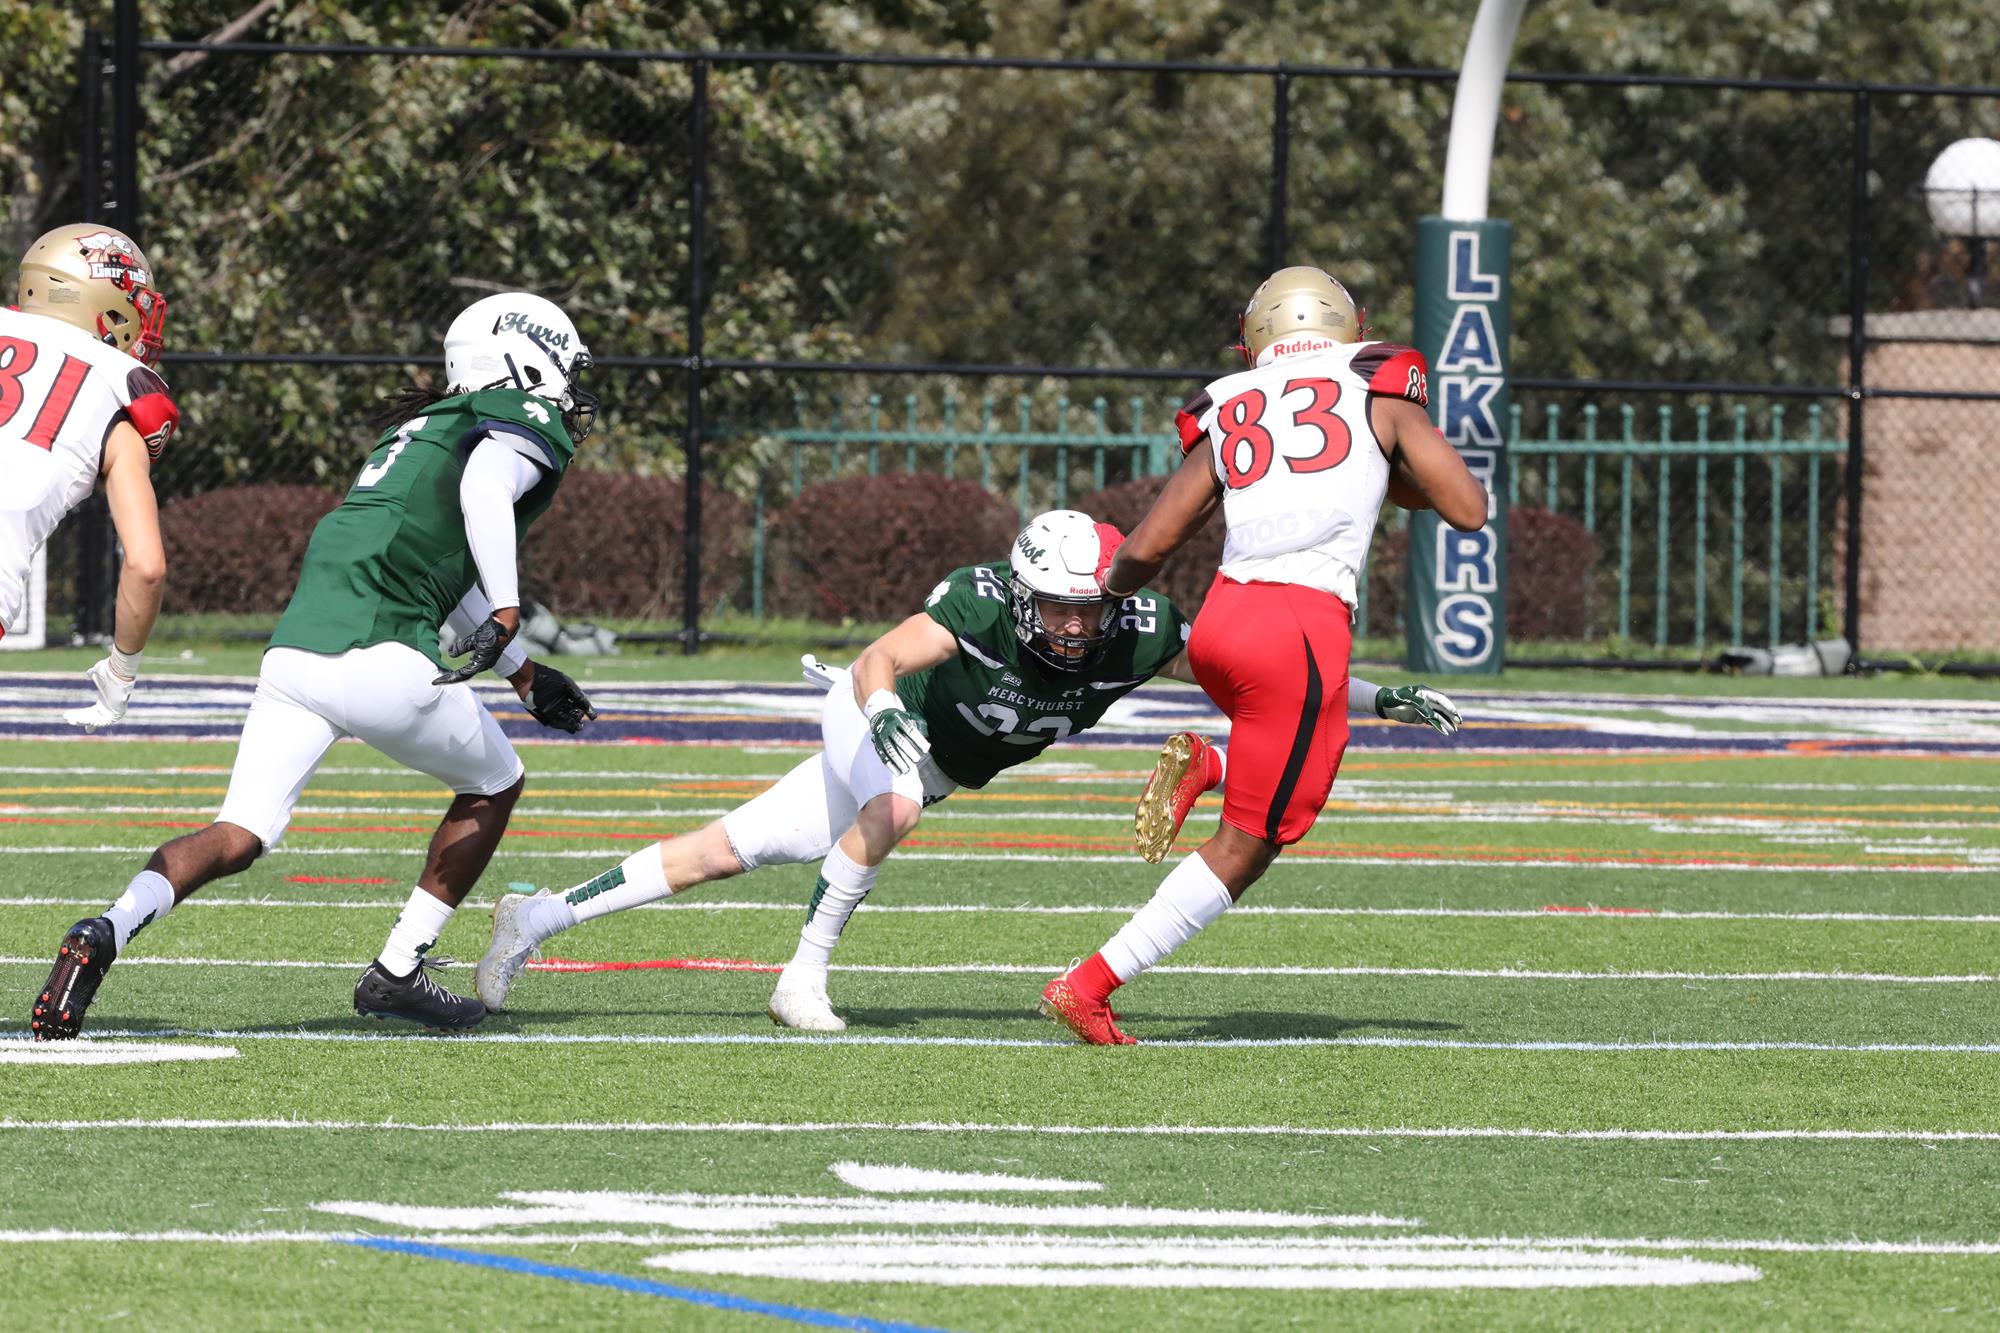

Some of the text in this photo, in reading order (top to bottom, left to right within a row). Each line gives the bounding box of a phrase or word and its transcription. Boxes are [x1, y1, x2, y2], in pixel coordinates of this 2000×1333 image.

[499, 311, 569, 351] Hurst
[1217, 377, 1352, 489] 83
[1069, 586, 1099, 595] Riddell
[1120, 595, 1156, 634] 22
[988, 686, 1084, 711] MERCYHURST
